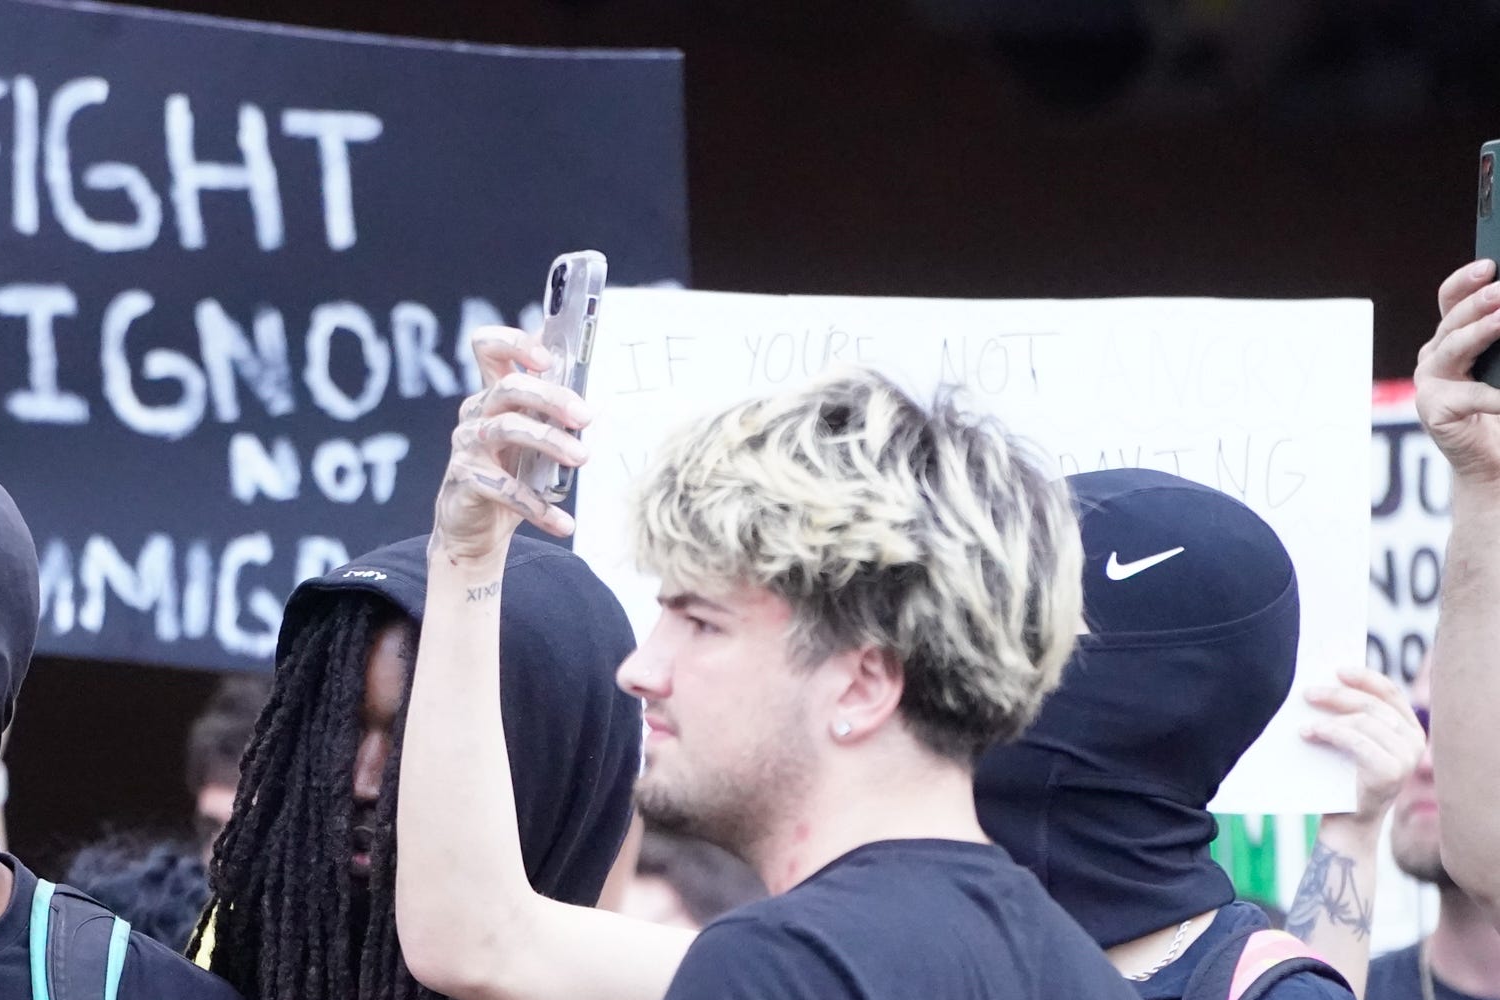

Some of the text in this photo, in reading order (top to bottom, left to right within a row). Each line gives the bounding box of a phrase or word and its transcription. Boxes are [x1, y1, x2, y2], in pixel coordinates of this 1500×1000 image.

[614, 332, 697, 395] IF
[940, 330, 1061, 397] NOT
[228, 431, 411, 504] NOT
